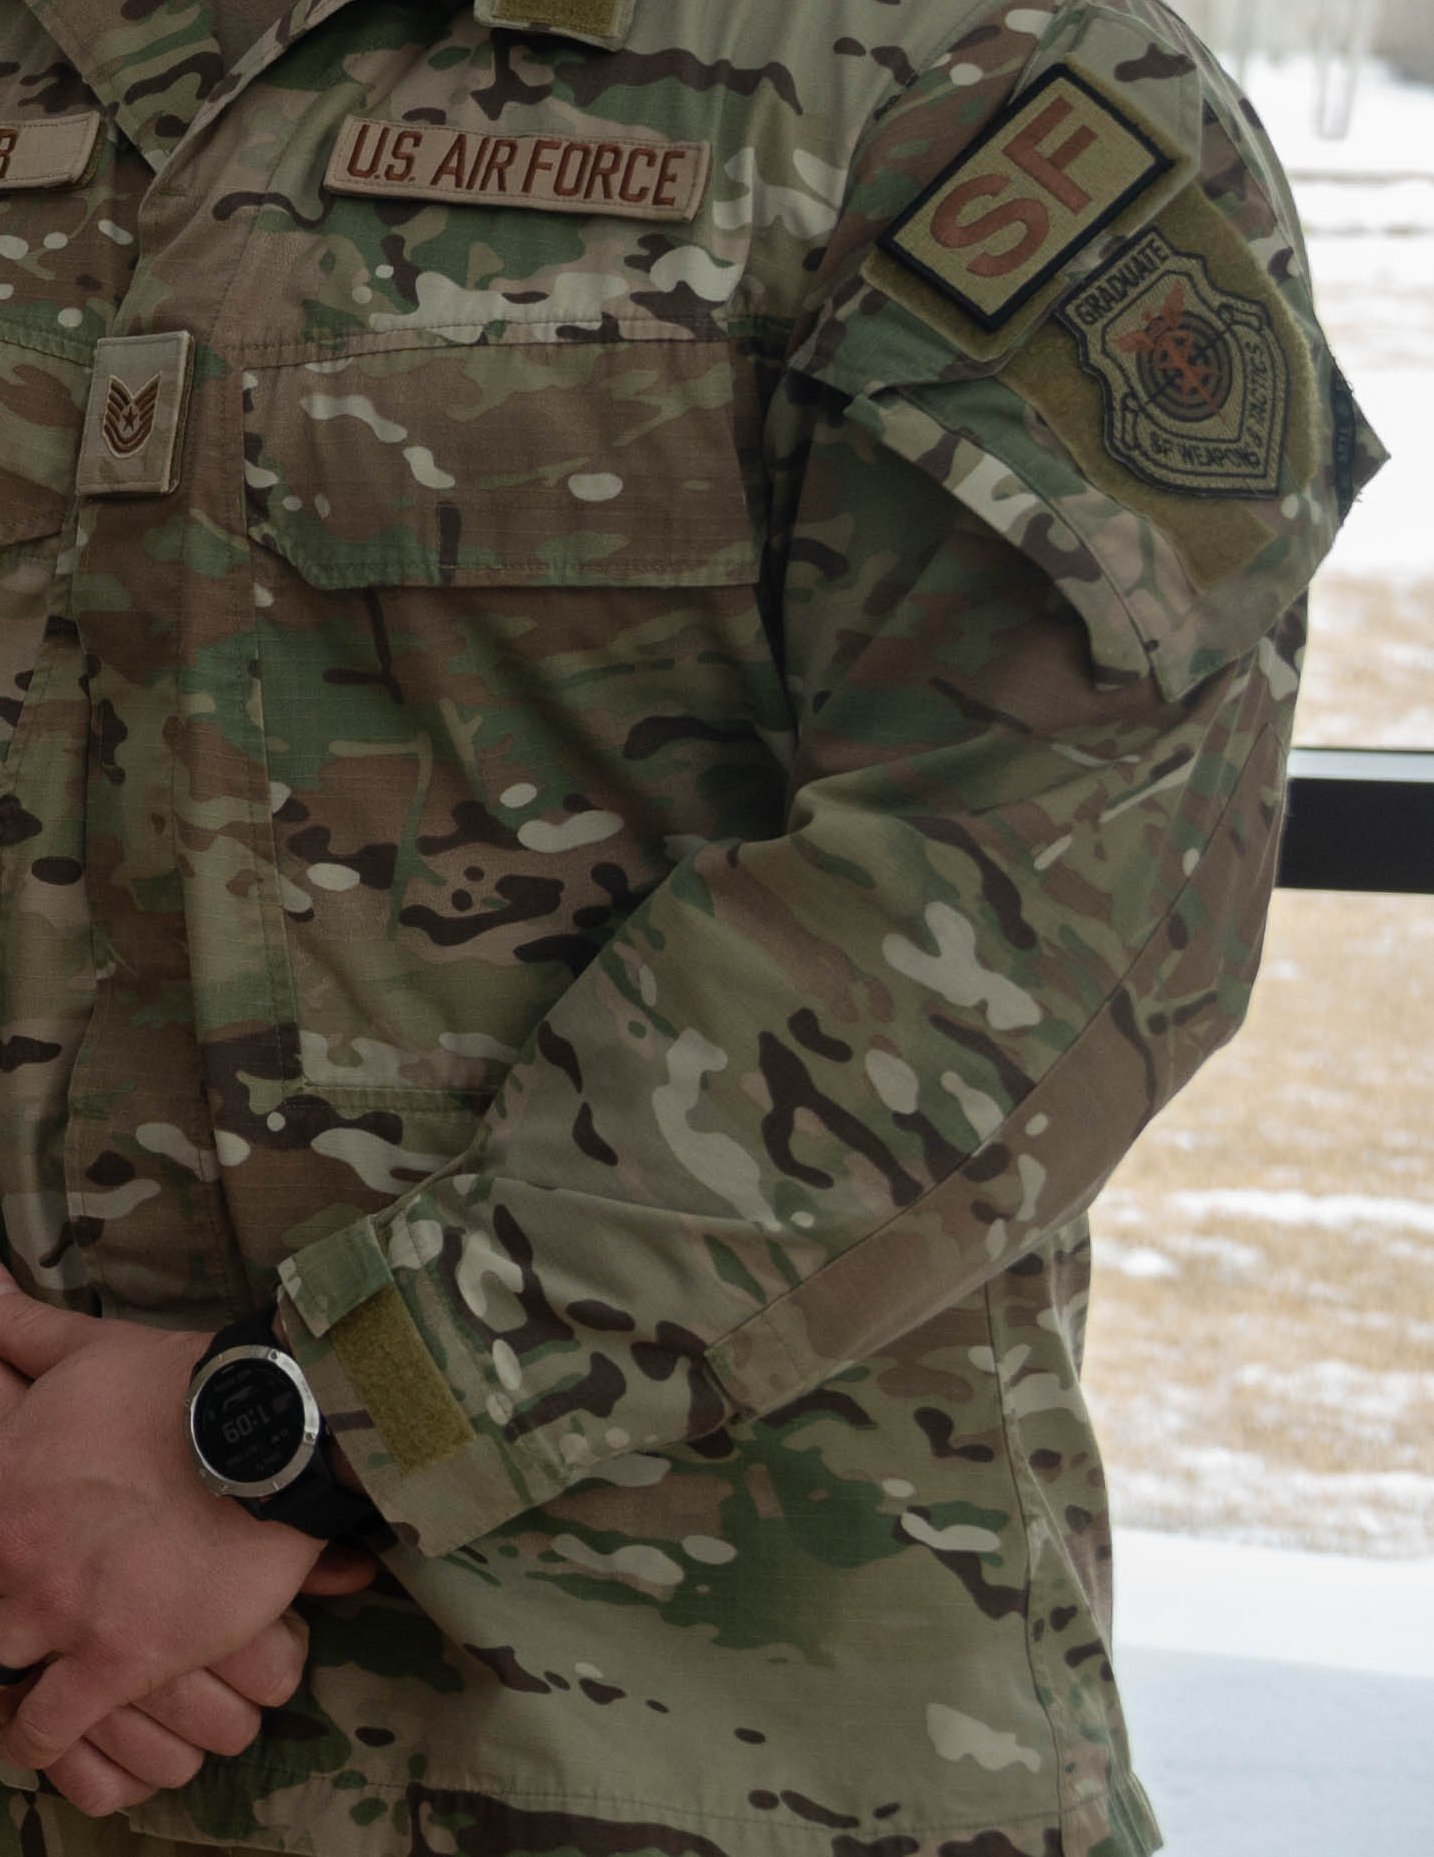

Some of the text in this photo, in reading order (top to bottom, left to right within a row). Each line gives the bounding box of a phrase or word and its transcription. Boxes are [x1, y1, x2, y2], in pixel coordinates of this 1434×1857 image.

[346, 123, 688, 207] U.S. AIR FORCE
[929, 94, 1098, 278] SF
[1073, 237, 1170, 326] GRADUATE
